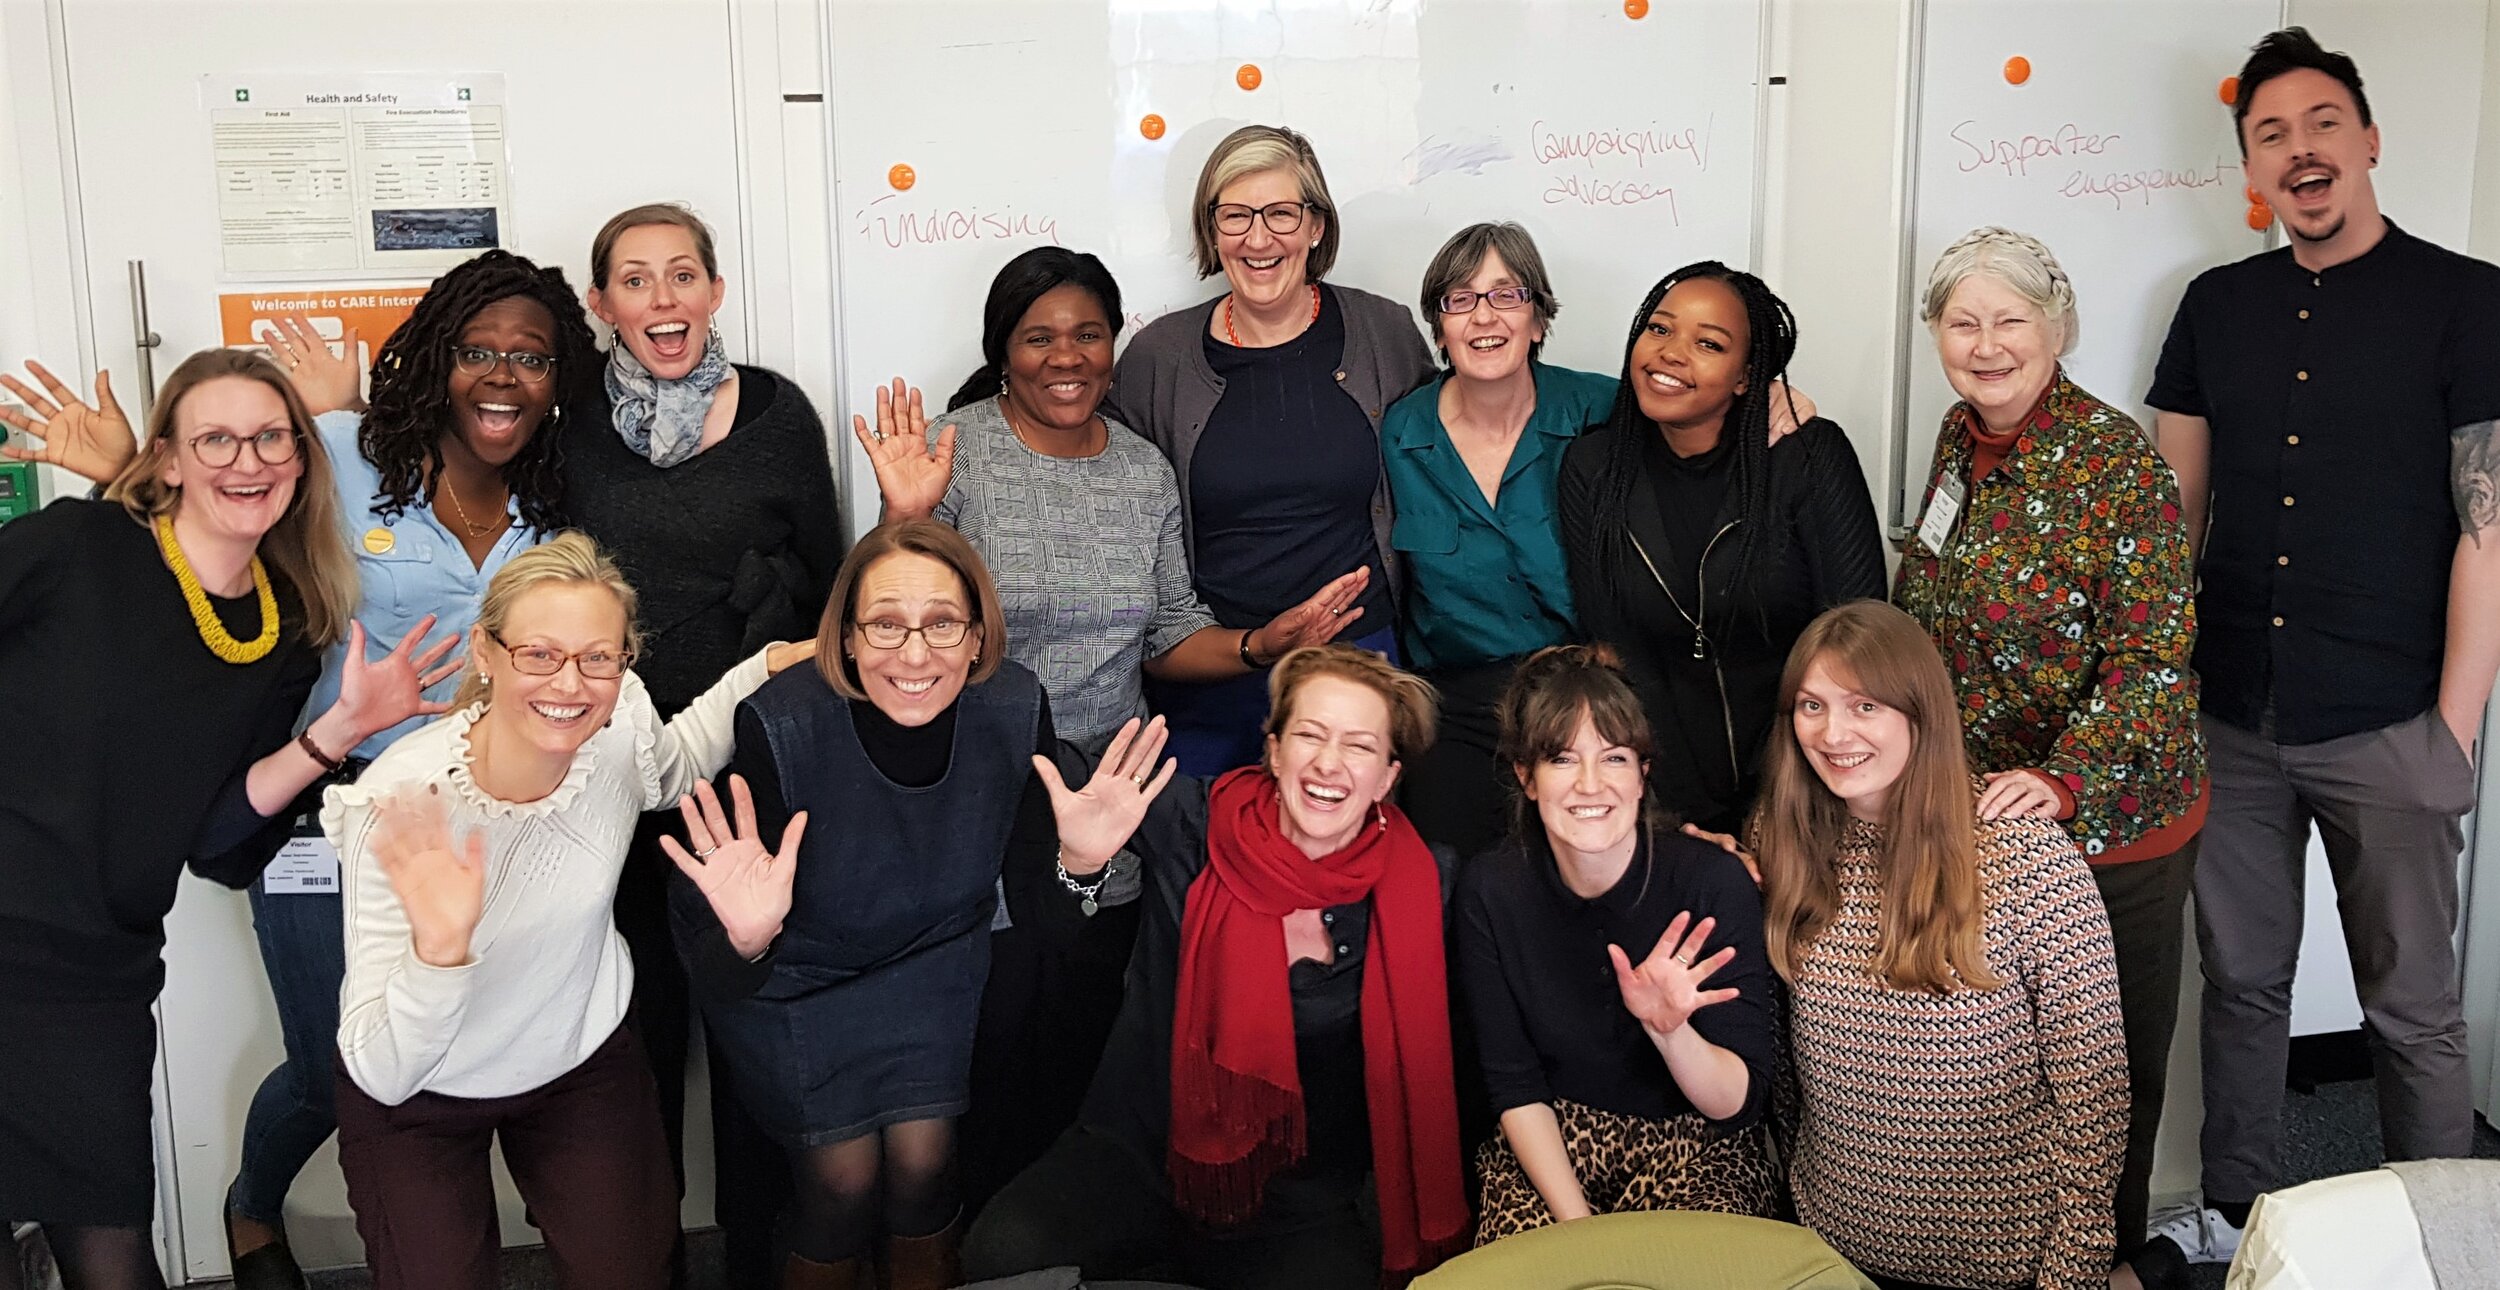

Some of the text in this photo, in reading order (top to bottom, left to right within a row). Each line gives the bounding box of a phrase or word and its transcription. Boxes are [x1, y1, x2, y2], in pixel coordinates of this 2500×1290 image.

[306, 93, 398, 105] Health and Safety
[1950, 120, 2121, 177] Supporter
[2058, 154, 2240, 211] engagement
[251, 298, 318, 311] Welcome
[321, 297, 336, 309] to
[339, 296, 375, 308] CARE
